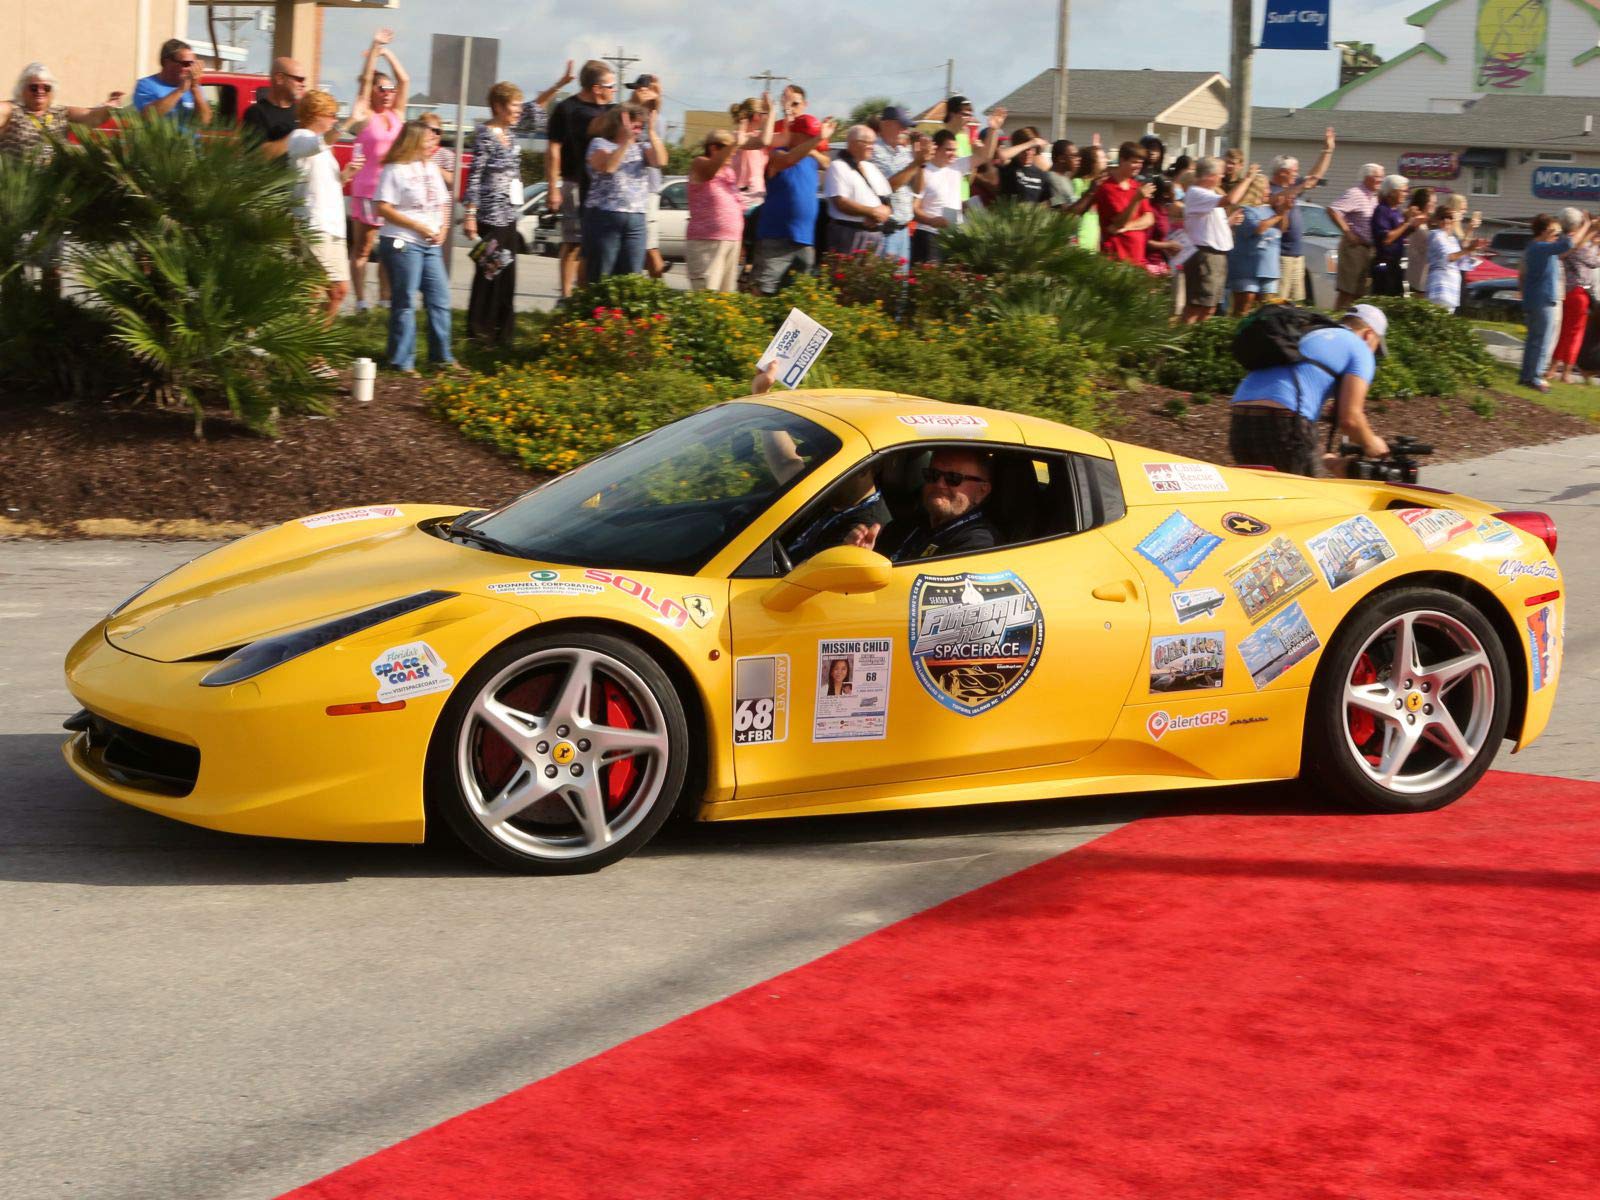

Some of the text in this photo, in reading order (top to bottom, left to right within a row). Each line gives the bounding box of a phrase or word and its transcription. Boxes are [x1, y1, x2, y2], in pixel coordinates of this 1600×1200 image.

[1267, 10, 1327, 26] Surf City
[1154, 481, 1180, 491] CRN
[488, 581, 603, 591] O'DONNELL CORPORATION
[585, 569, 689, 628] SOLO
[929, 596, 948, 605] SEASON
[960, 617, 1006, 643] RUN
[821, 641, 889, 654] MISSING CHILD
[935, 642, 1020, 658] SPACE RACE
[1287, 633, 1316, 656] GEORGIA
[776, 657, 787, 689] ARMY
[865, 672, 877, 682] 68
[1000, 676, 1025, 700] FLORENCE
[735, 699, 774, 732] 68
[1169, 710, 1227, 729] alertGPS
[747, 729, 772, 742] FBR
